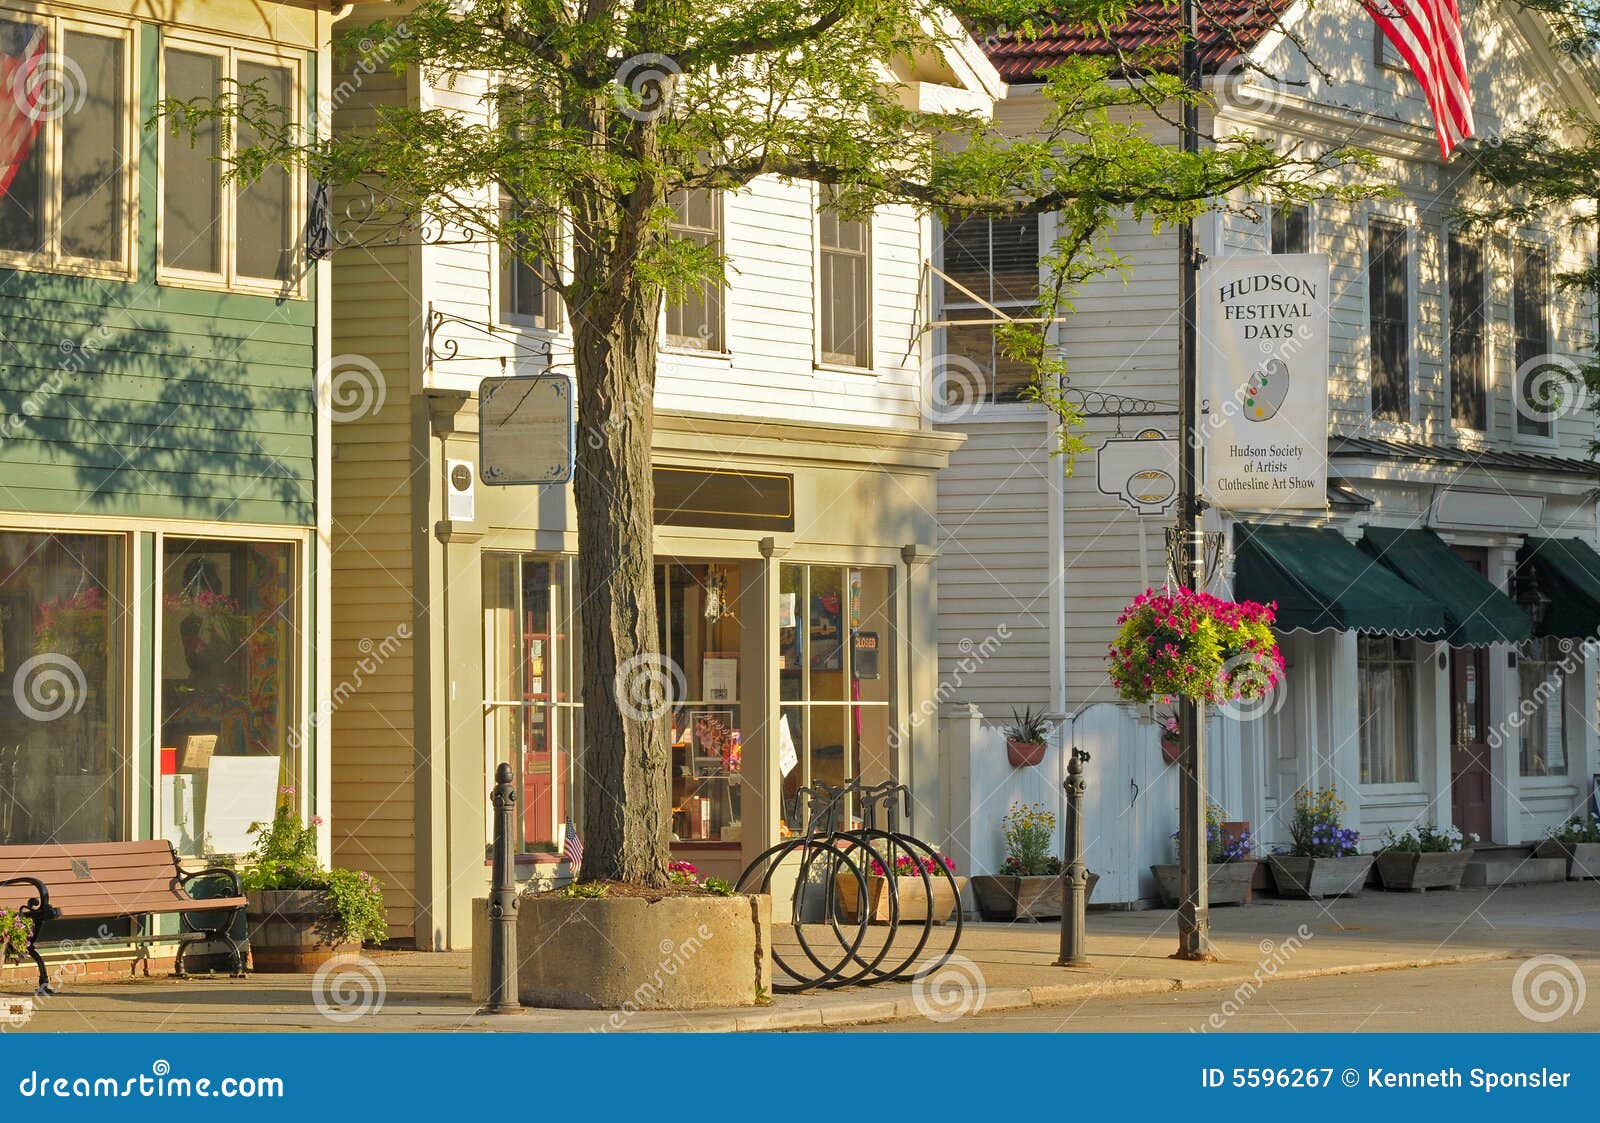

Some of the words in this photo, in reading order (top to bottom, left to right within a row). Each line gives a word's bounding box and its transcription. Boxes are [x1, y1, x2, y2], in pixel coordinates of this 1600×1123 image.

[1219, 274, 1317, 304] HUDSON
[1225, 303, 1312, 320] FESTIVAL
[1244, 323, 1294, 340] DAYS
[1230, 444, 1267, 457] Hudson
[1269, 444, 1304, 461] Society
[1244, 460, 1254, 473] of
[1256, 460, 1287, 473] Artists
[1218, 478, 1269, 491] Clothesline
[1271, 477, 1286, 490] Art
[1288, 476, 1315, 490] Show
[855, 636, 876, 649] CLOSED
